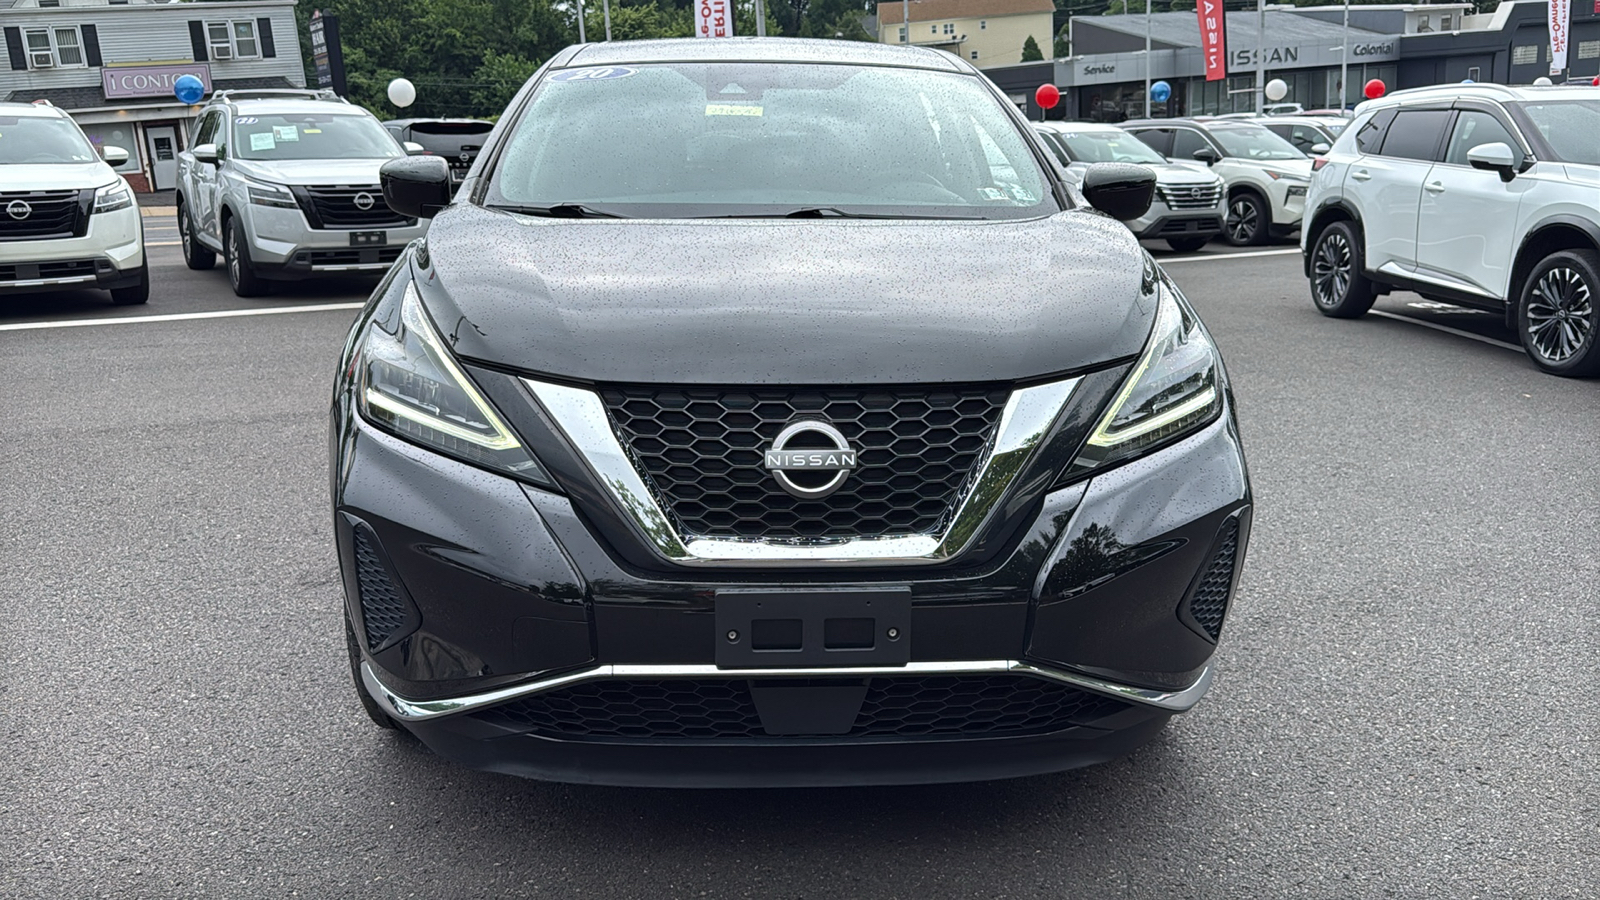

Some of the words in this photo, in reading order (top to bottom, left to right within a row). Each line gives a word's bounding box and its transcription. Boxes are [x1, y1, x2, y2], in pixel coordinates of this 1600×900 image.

[1353, 43, 1394, 56] Colonial
[566, 68, 615, 80] 20
[1083, 64, 1115, 75] Service
[121, 73, 202, 90] CONT
[767, 454, 855, 466] NISSAN
